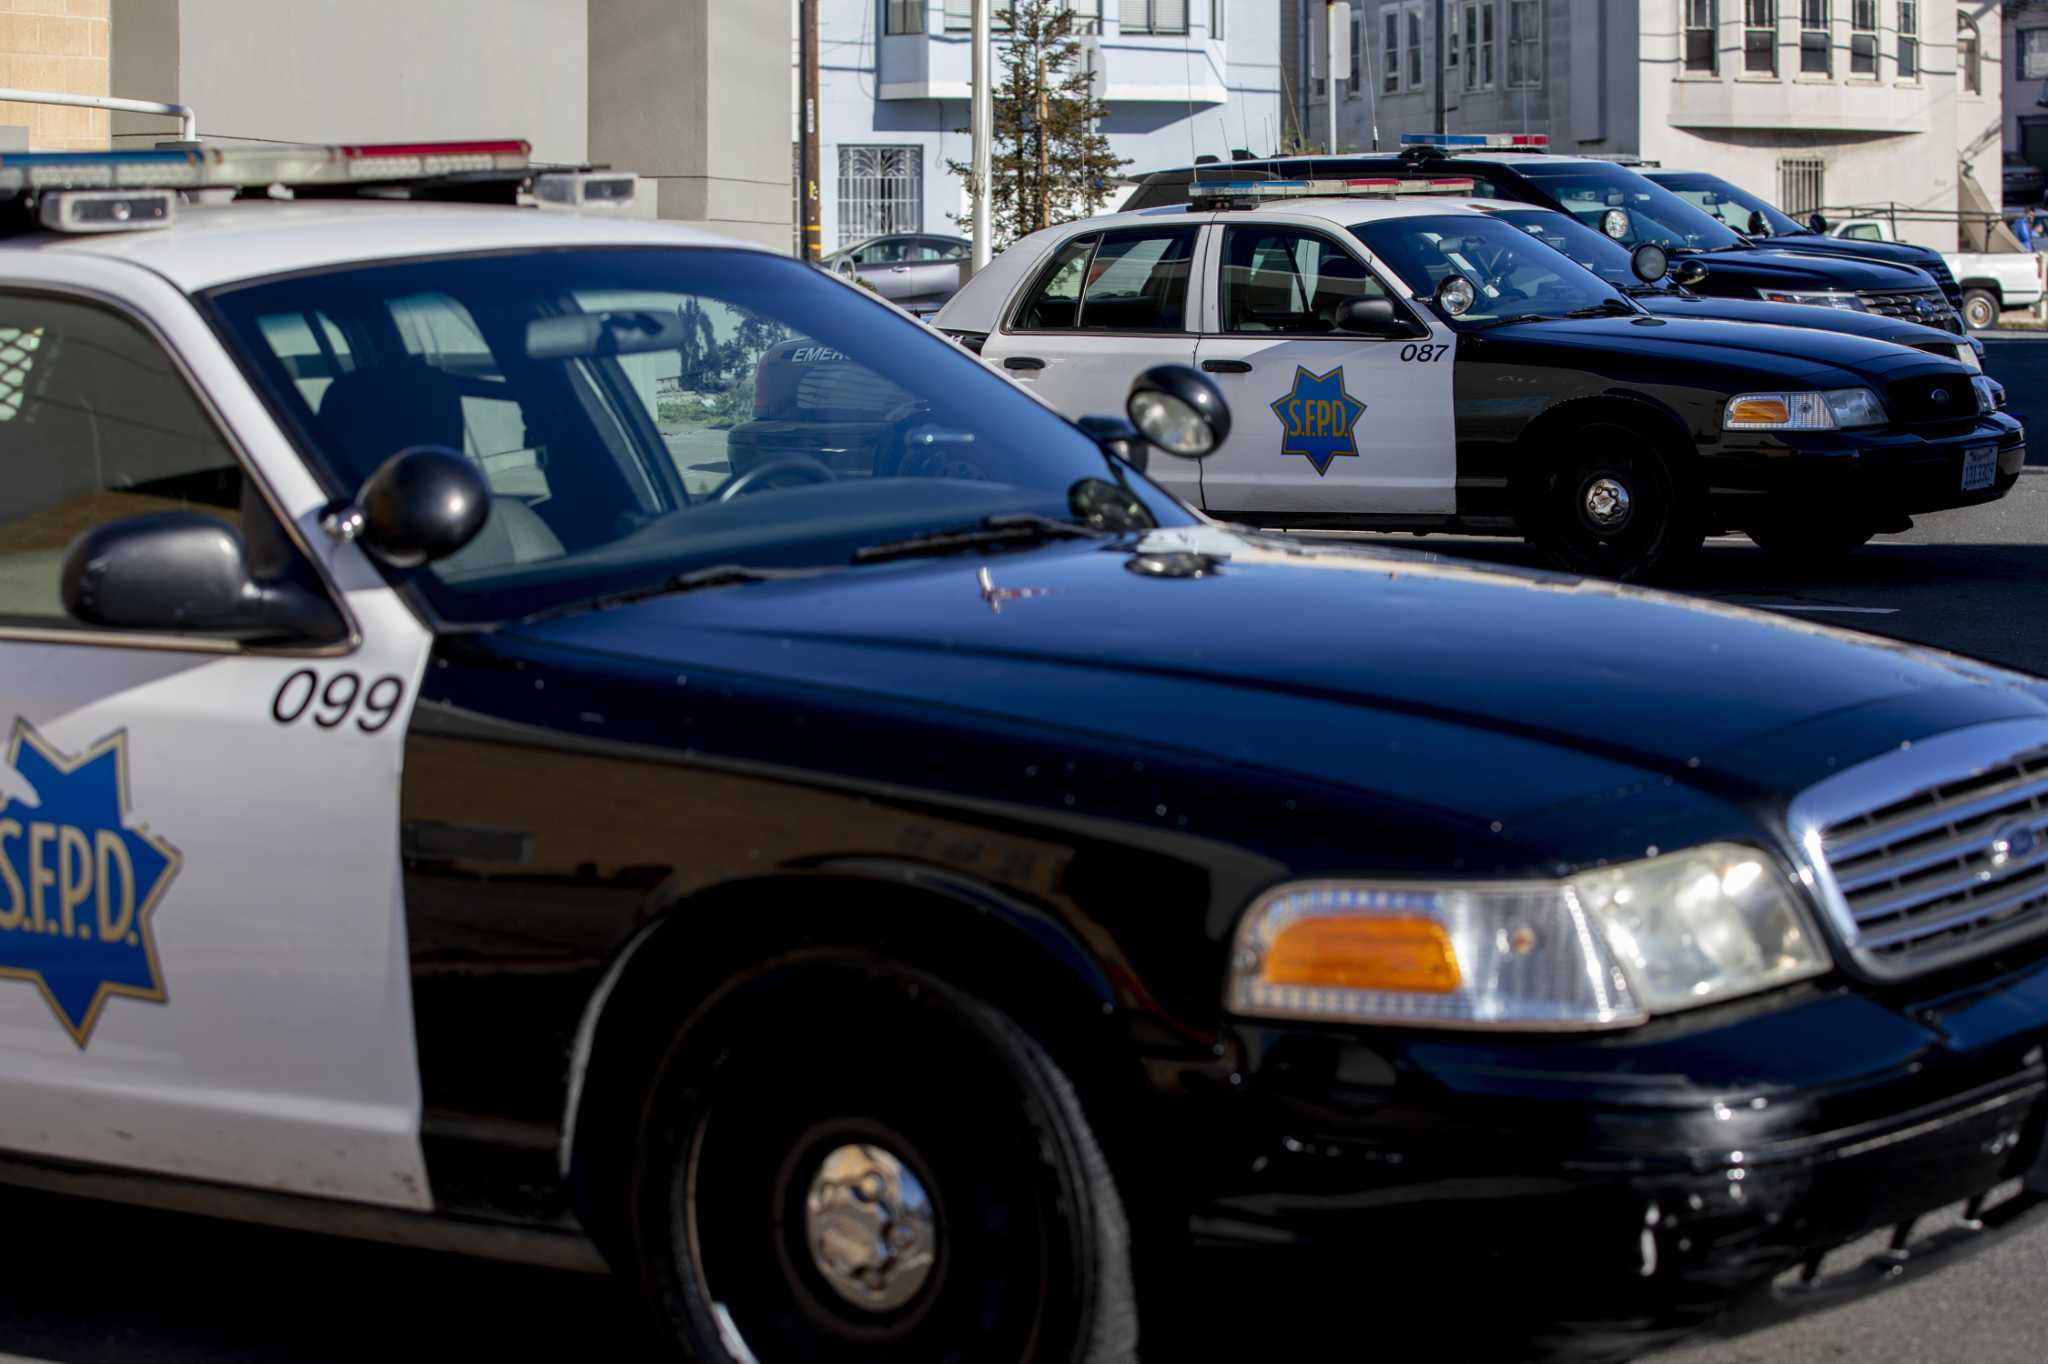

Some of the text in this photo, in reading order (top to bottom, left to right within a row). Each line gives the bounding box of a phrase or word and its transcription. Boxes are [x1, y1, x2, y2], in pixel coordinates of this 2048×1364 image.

[792, 347, 852, 362] EMER
[1400, 344, 1449, 362] 087
[1289, 400, 1348, 437] S.F.P.D.
[272, 669, 403, 734] 099
[0, 818, 138, 945] S.F.P.D.
